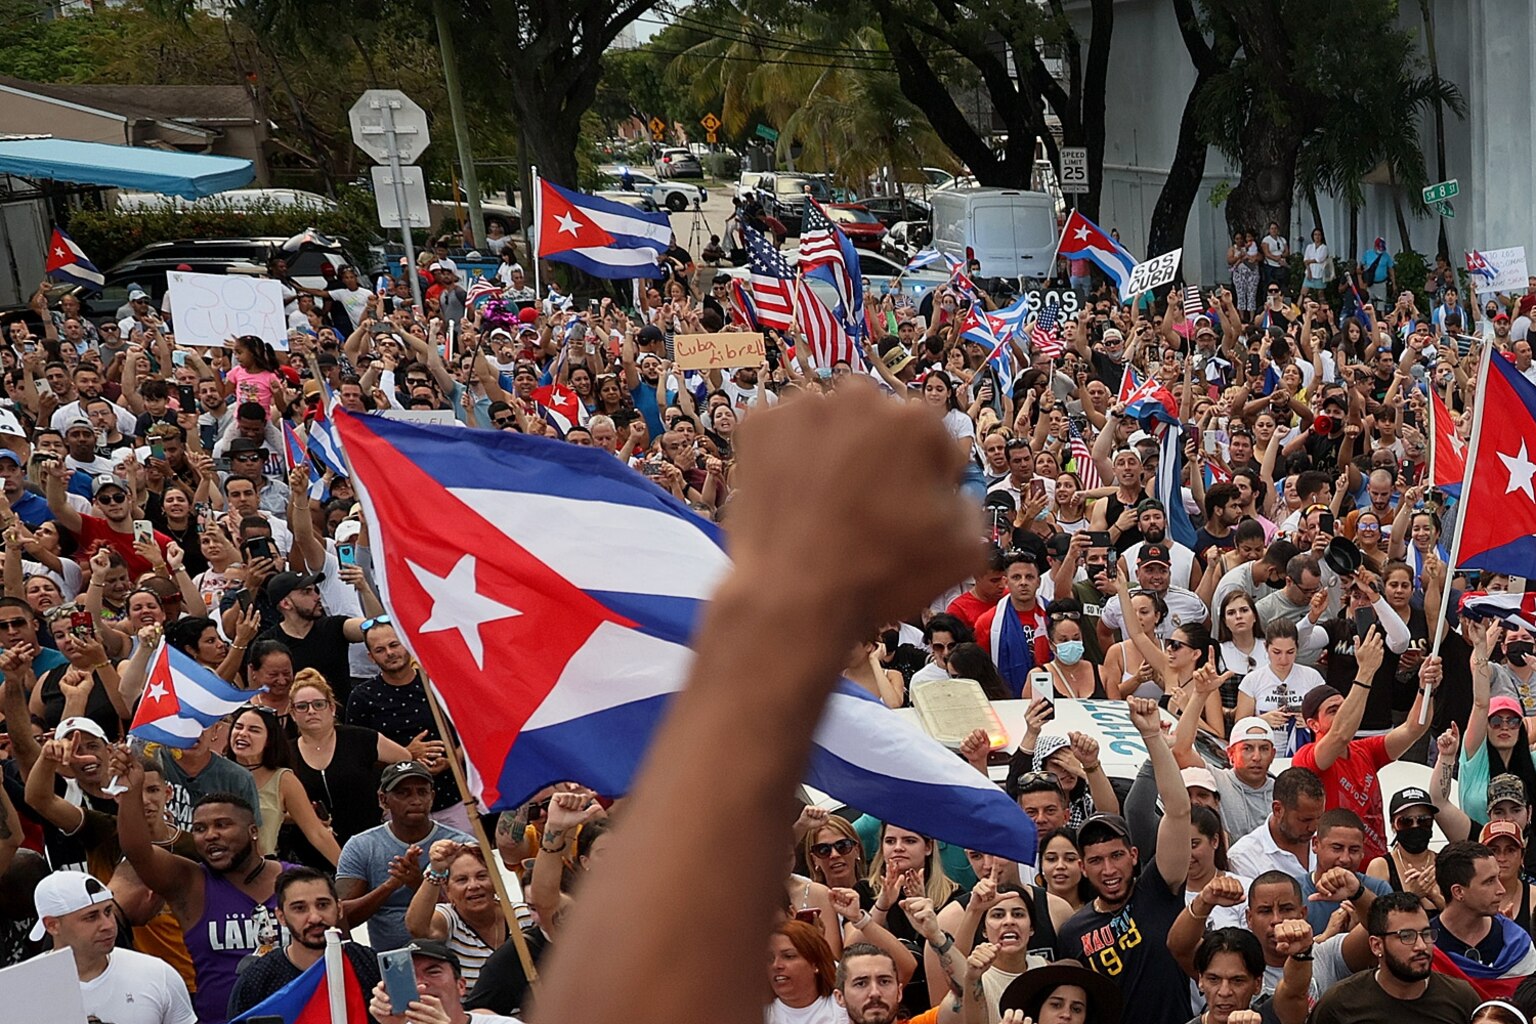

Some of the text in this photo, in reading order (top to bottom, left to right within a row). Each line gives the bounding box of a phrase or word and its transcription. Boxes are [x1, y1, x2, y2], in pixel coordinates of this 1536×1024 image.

[1063, 166, 1085, 180] 25
[1439, 185, 1446, 197] 8
[1135, 253, 1174, 280] SOS
[1129, 264, 1174, 295] CUBA
[190, 274, 276, 315] SOS
[1028, 290, 1078, 312] SOS
[184, 306, 278, 345] CUBA
[677, 338, 716, 357] Cuba
